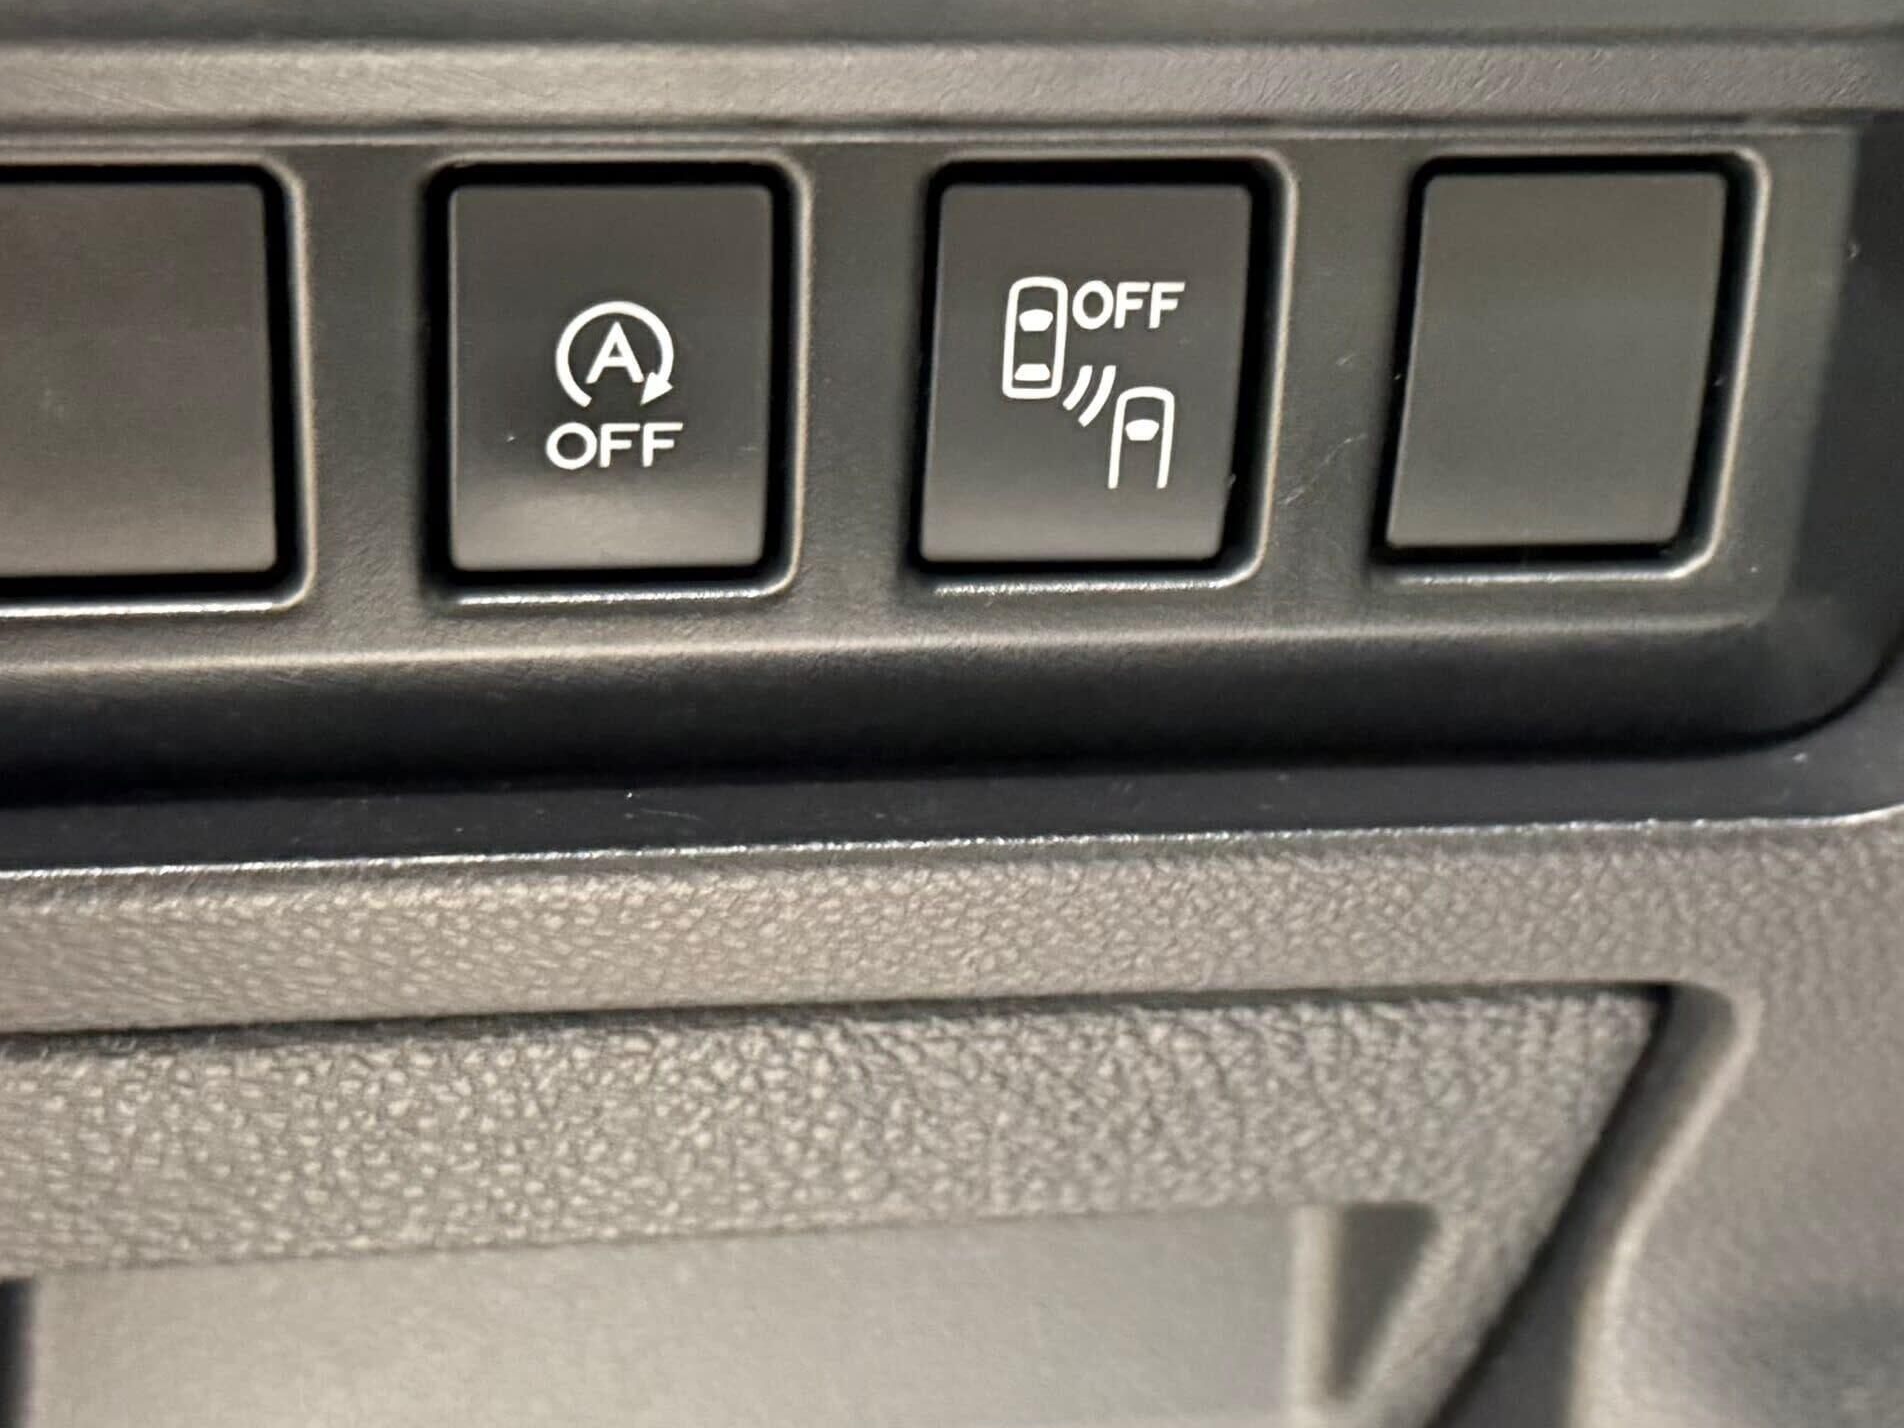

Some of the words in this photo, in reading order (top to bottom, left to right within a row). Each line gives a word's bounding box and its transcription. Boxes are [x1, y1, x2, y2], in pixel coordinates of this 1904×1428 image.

[1070, 279, 1186, 330] OFF
[585, 321, 645, 384] A
[545, 421, 684, 470] OFF
